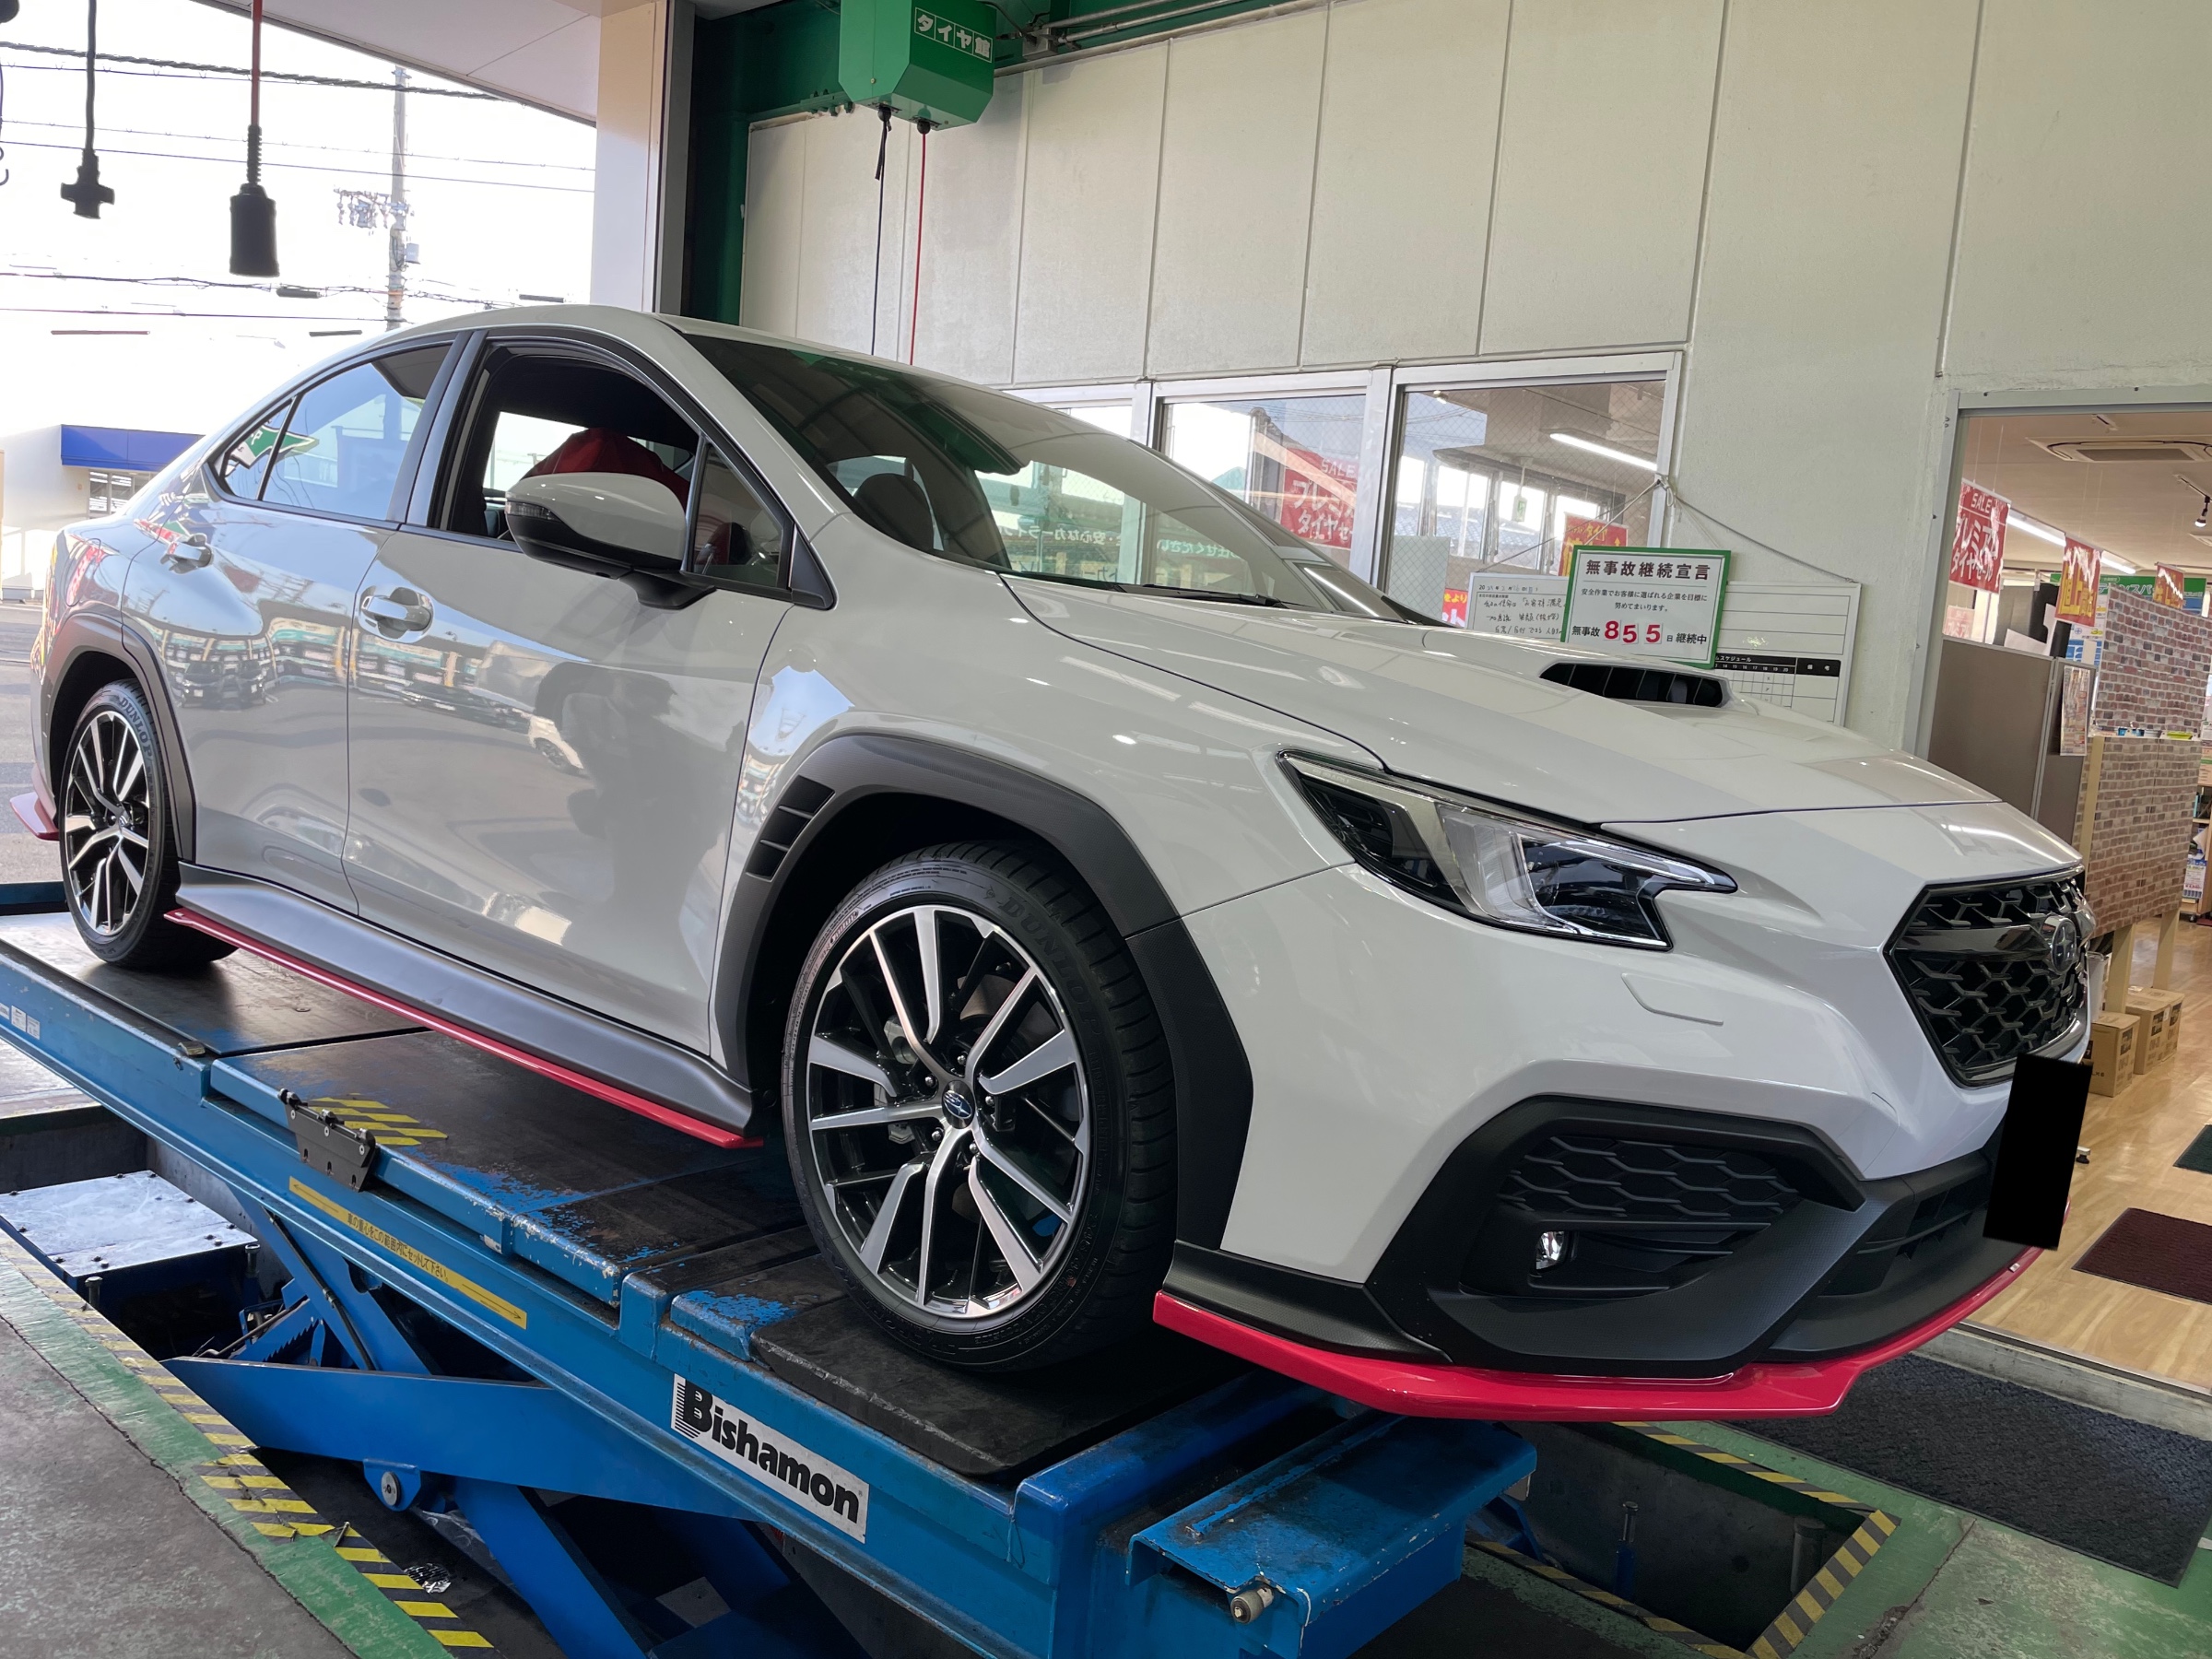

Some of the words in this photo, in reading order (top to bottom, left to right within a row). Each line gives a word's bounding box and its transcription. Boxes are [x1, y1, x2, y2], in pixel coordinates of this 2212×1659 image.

[917, 14, 991, 58] タイヤ館
[1322, 460, 1356, 477] SALE
[1292, 479, 1354, 518] プレミ
[1971, 492, 1993, 513] SALE
[1298, 509, 1353, 543] タイヤセ
[1585, 559, 1711, 581] 無事故継続宣言
[1581, 588, 1708, 602] 安全作業でお客様に選ばれる企業を目標に
[1614, 602, 1668, 612] 努めてまいります。
[1571, 625, 1600, 637] 無事故
[1604, 620, 1661, 643] 855
[119, 697, 153, 757] DUNLOP
[998, 896, 1104, 1035] DUNLOP
[682, 1379, 860, 1524] Bishamon
